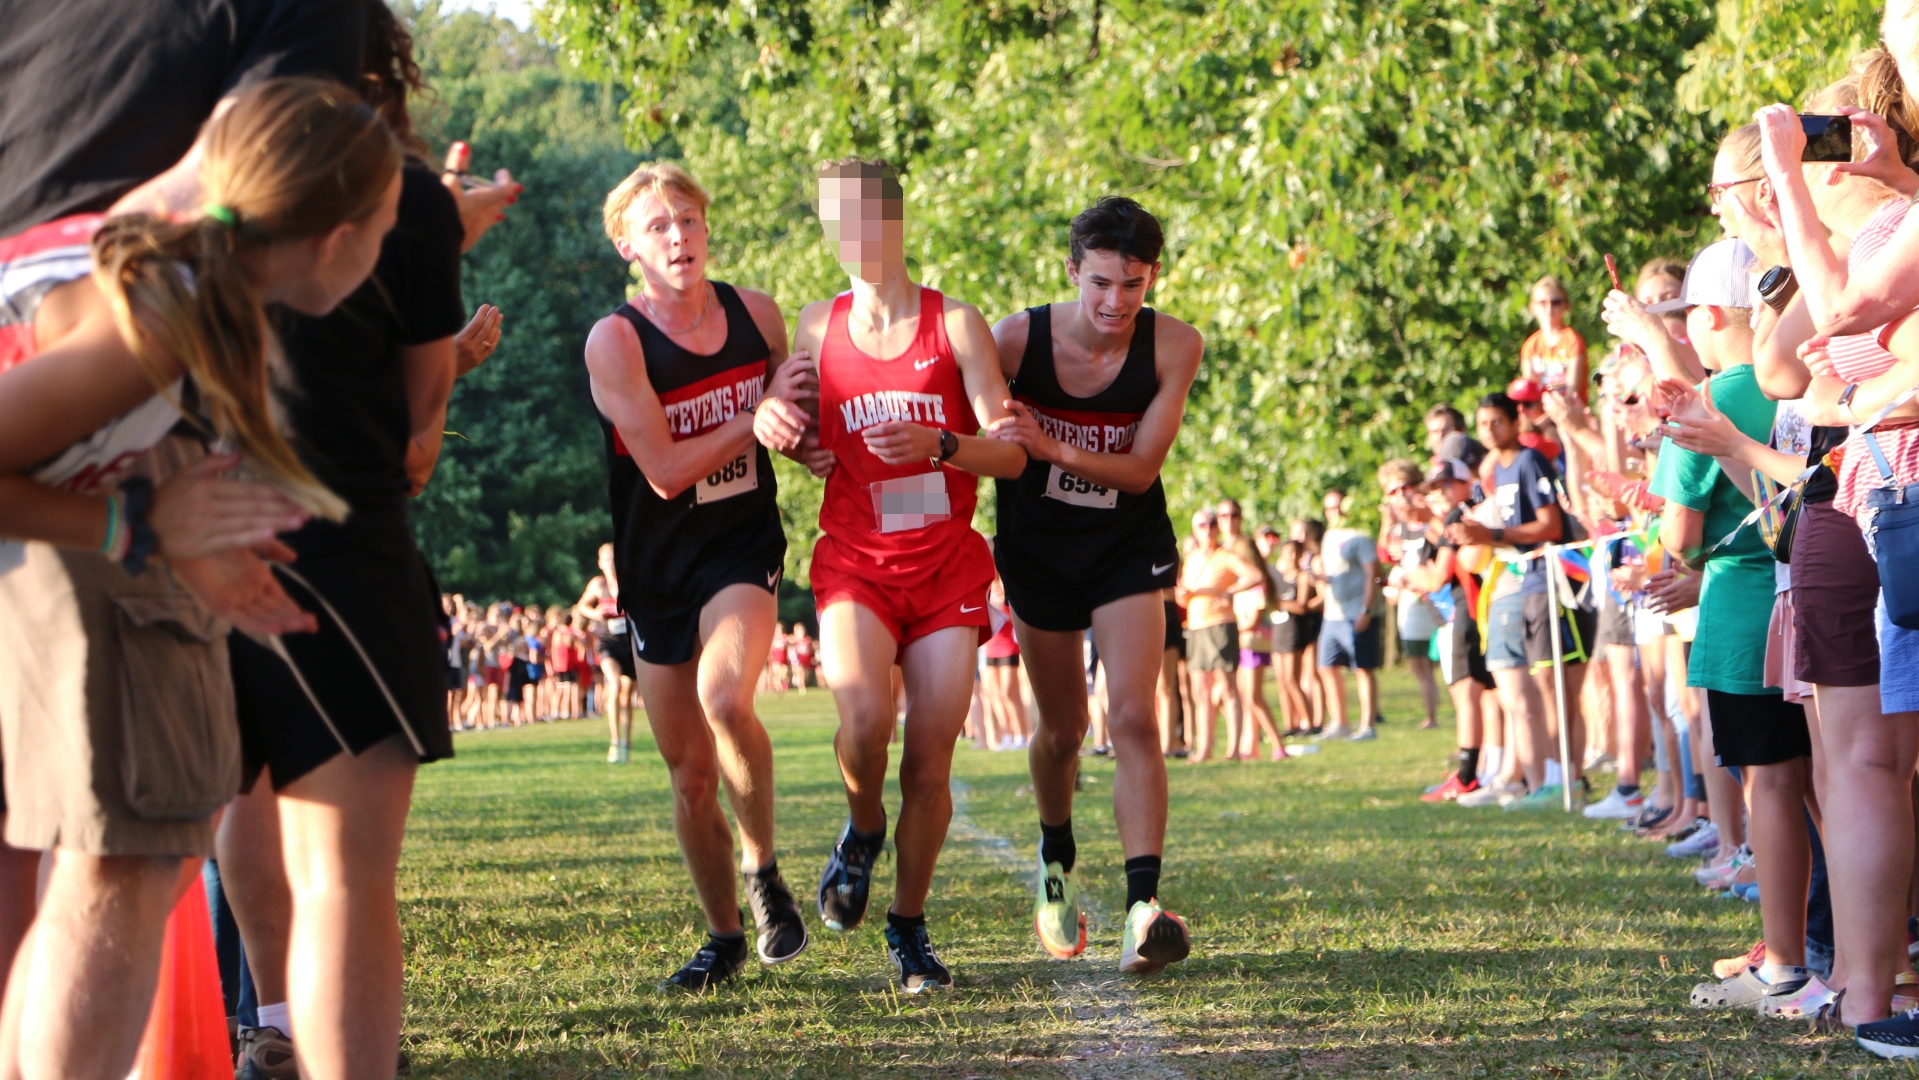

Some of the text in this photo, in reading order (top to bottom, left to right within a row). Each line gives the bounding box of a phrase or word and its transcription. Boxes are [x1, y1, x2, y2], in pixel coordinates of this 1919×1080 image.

[665, 373, 766, 434] TEVENS POIN
[839, 390, 947, 434] MARQUETTE
[1058, 471, 1109, 497] 654
